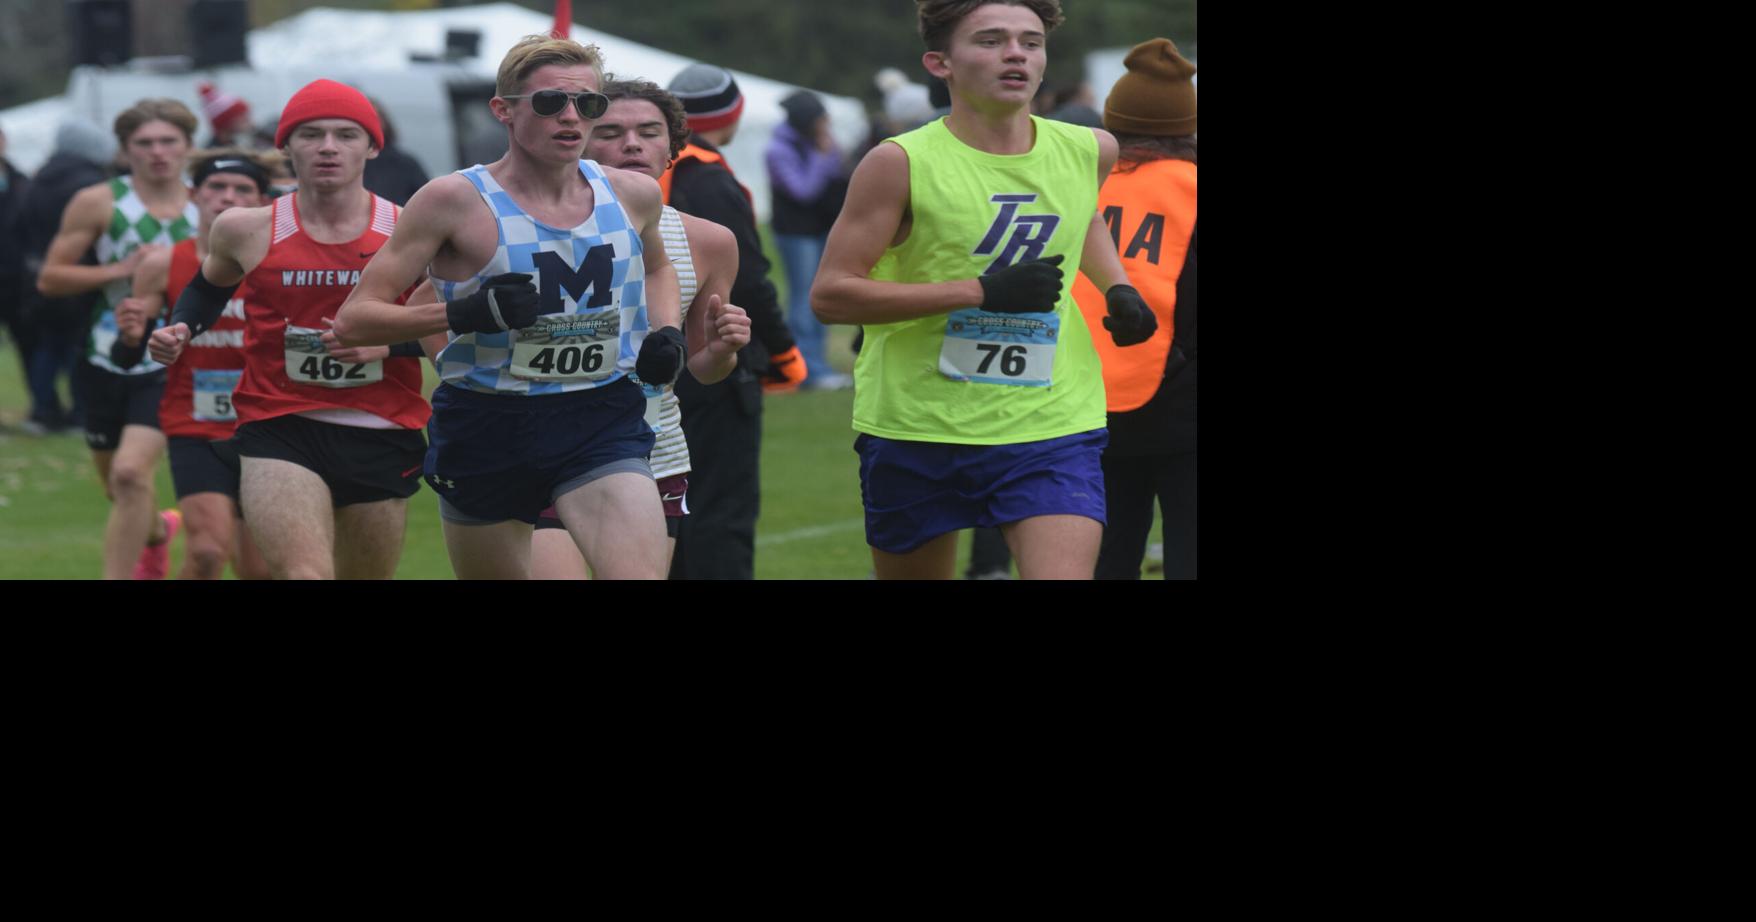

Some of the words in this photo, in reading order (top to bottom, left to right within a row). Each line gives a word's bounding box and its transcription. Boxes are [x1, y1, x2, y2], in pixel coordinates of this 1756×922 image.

[532, 243, 616, 315] M
[300, 356, 366, 380] 462
[528, 344, 604, 374] 406
[976, 343, 1027, 376] 76
